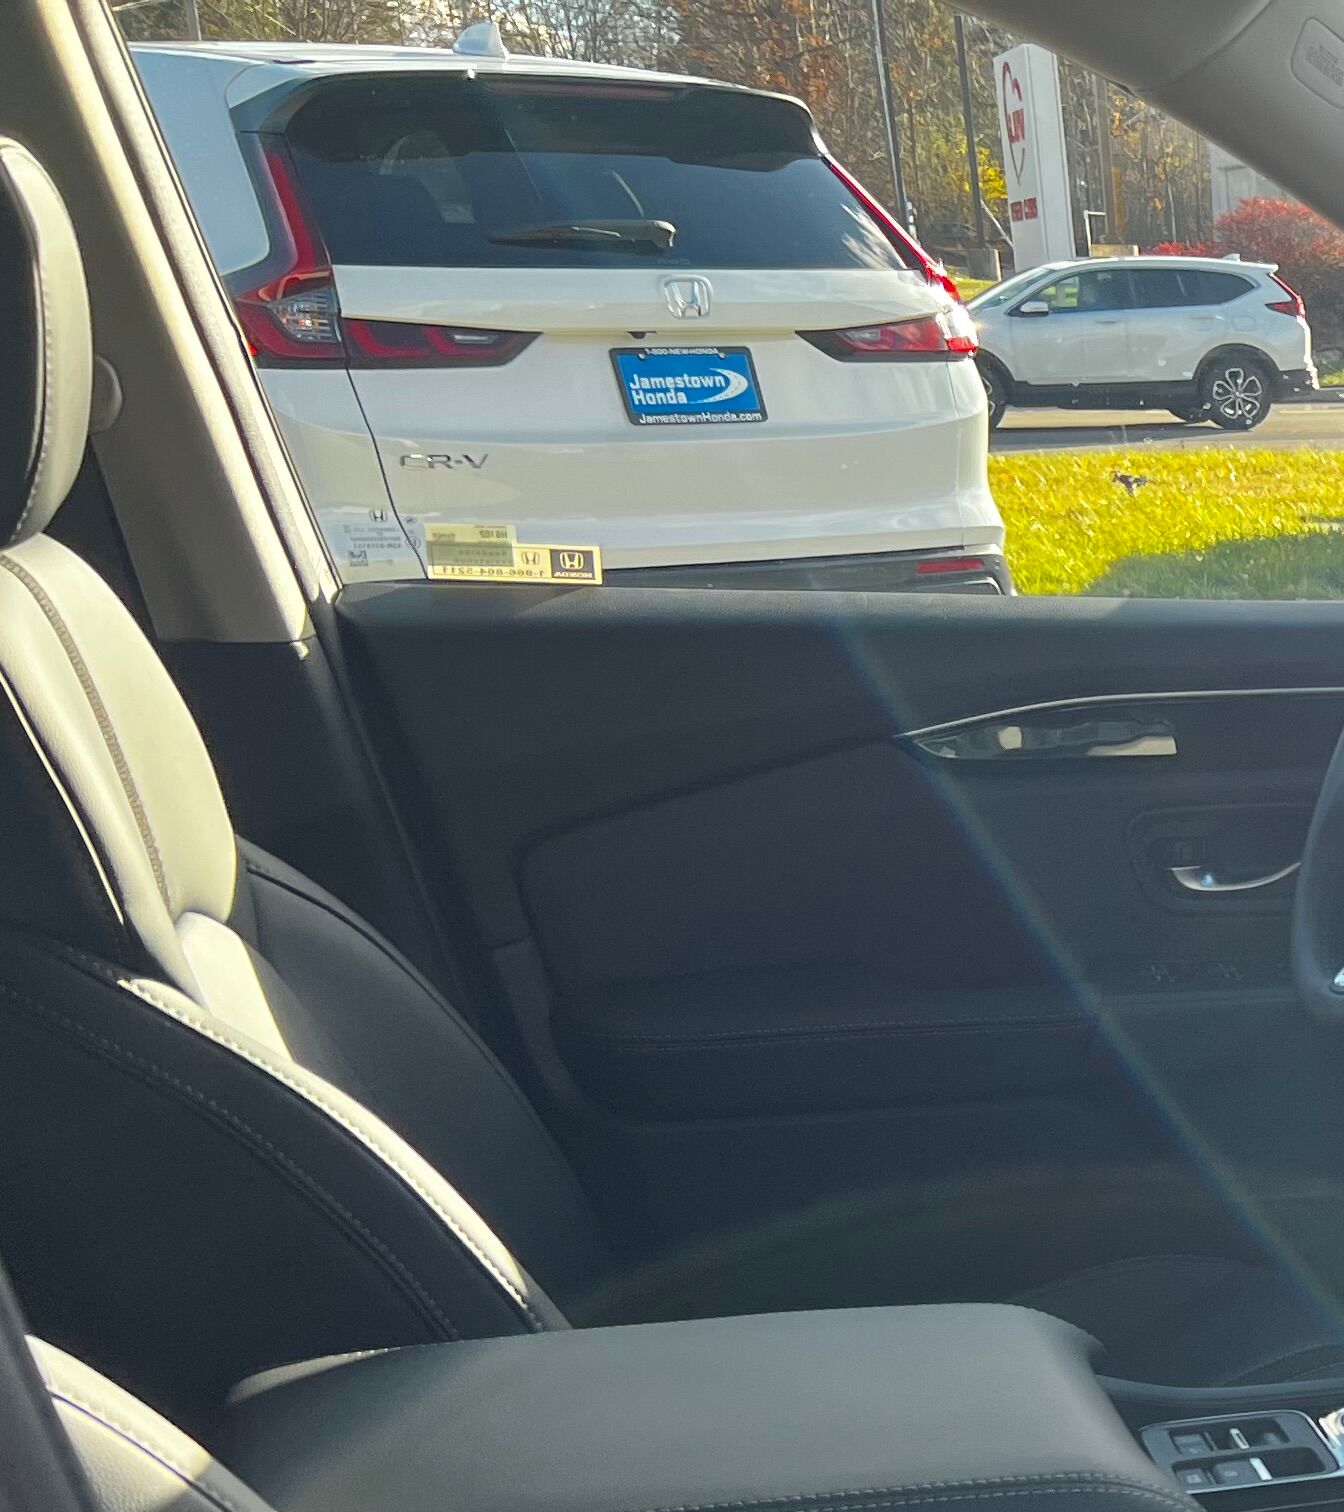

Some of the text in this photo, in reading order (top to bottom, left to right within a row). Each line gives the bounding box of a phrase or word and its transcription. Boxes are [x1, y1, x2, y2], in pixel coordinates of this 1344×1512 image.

[629, 373, 726, 390] Jamestown
[632, 389, 688, 405] Honda
[639, 411, 763, 425] JamestownHonda.com
[400, 454, 489, 470] CR-V
